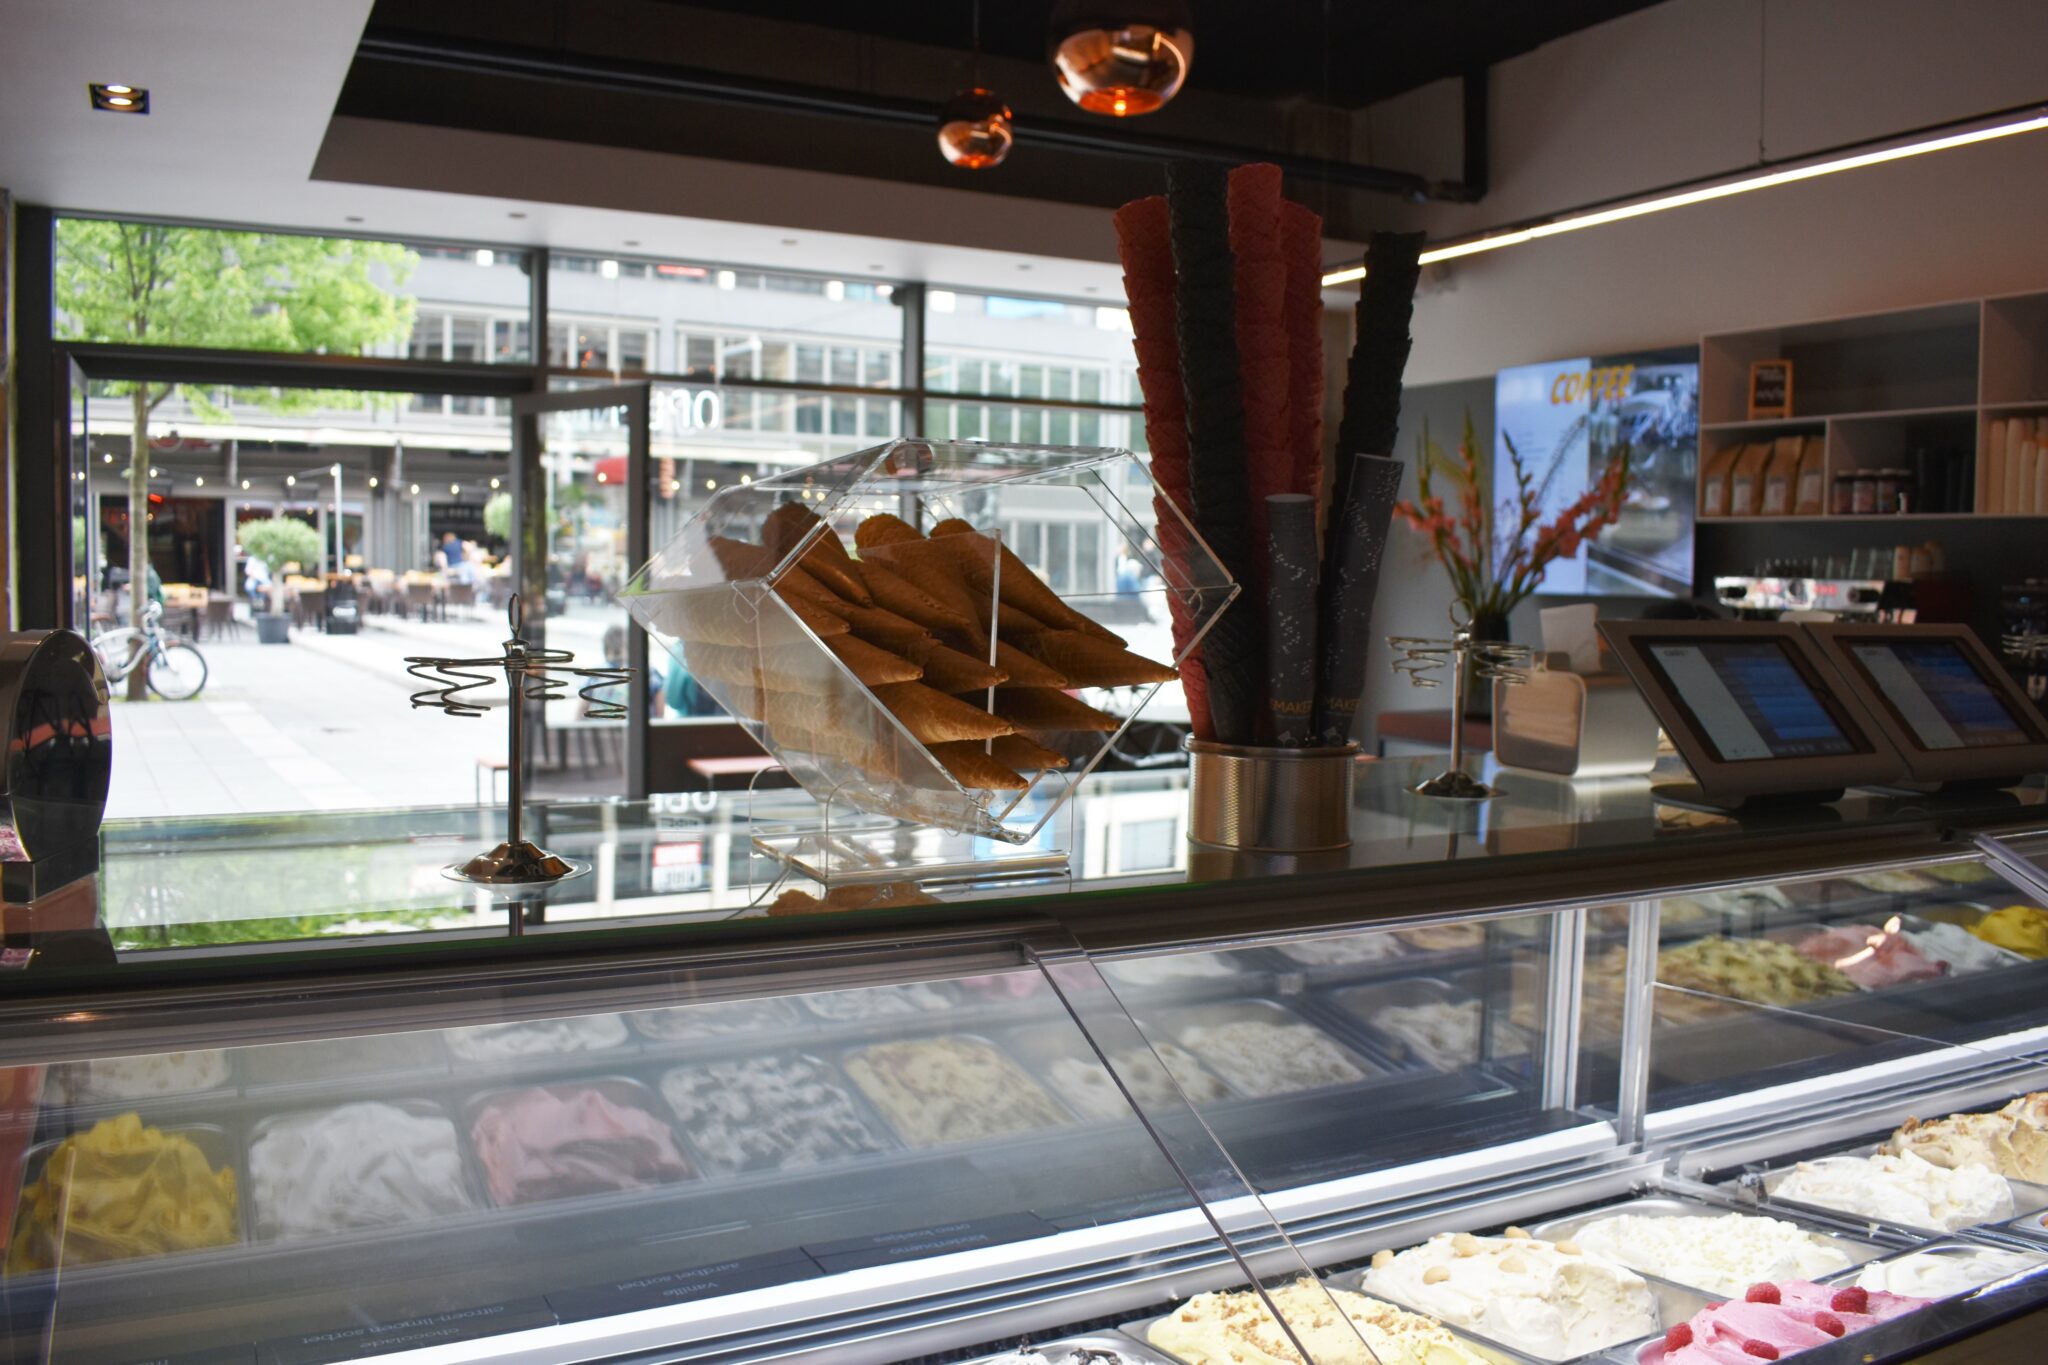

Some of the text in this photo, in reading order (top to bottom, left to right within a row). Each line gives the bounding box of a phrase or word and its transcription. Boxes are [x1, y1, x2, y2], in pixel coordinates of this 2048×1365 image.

[1551, 364, 1636, 405] COFFEE
[616, 1275, 672, 1291] sorbet
[662, 1282, 719, 1296] vanille
[302, 1328, 365, 1345] sorbet
[361, 1327, 460, 1348] chocolade
